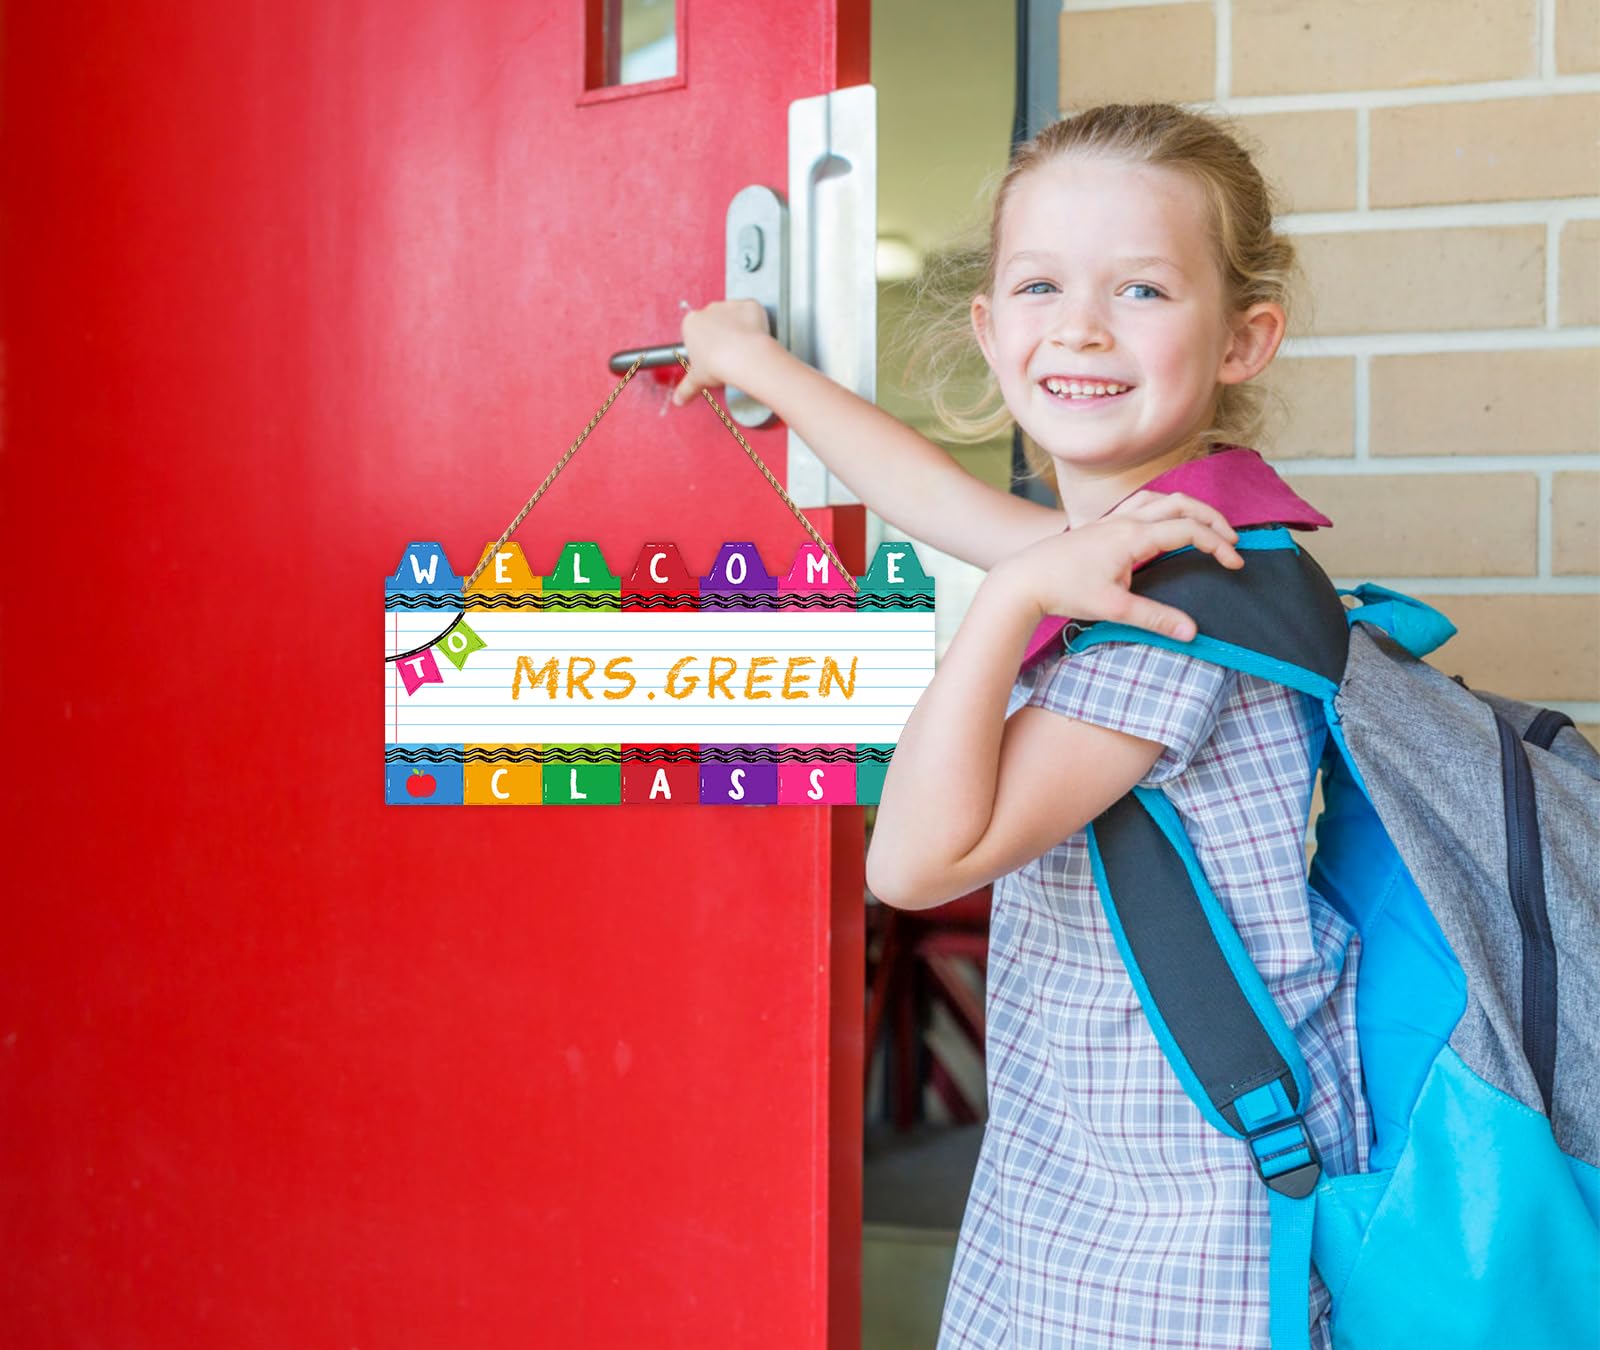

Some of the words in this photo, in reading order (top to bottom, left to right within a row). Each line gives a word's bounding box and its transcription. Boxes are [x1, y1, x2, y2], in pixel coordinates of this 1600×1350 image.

[409, 552, 906, 584] WELCOME
[404, 631, 468, 679] TO
[491, 768, 825, 801] CLASS
